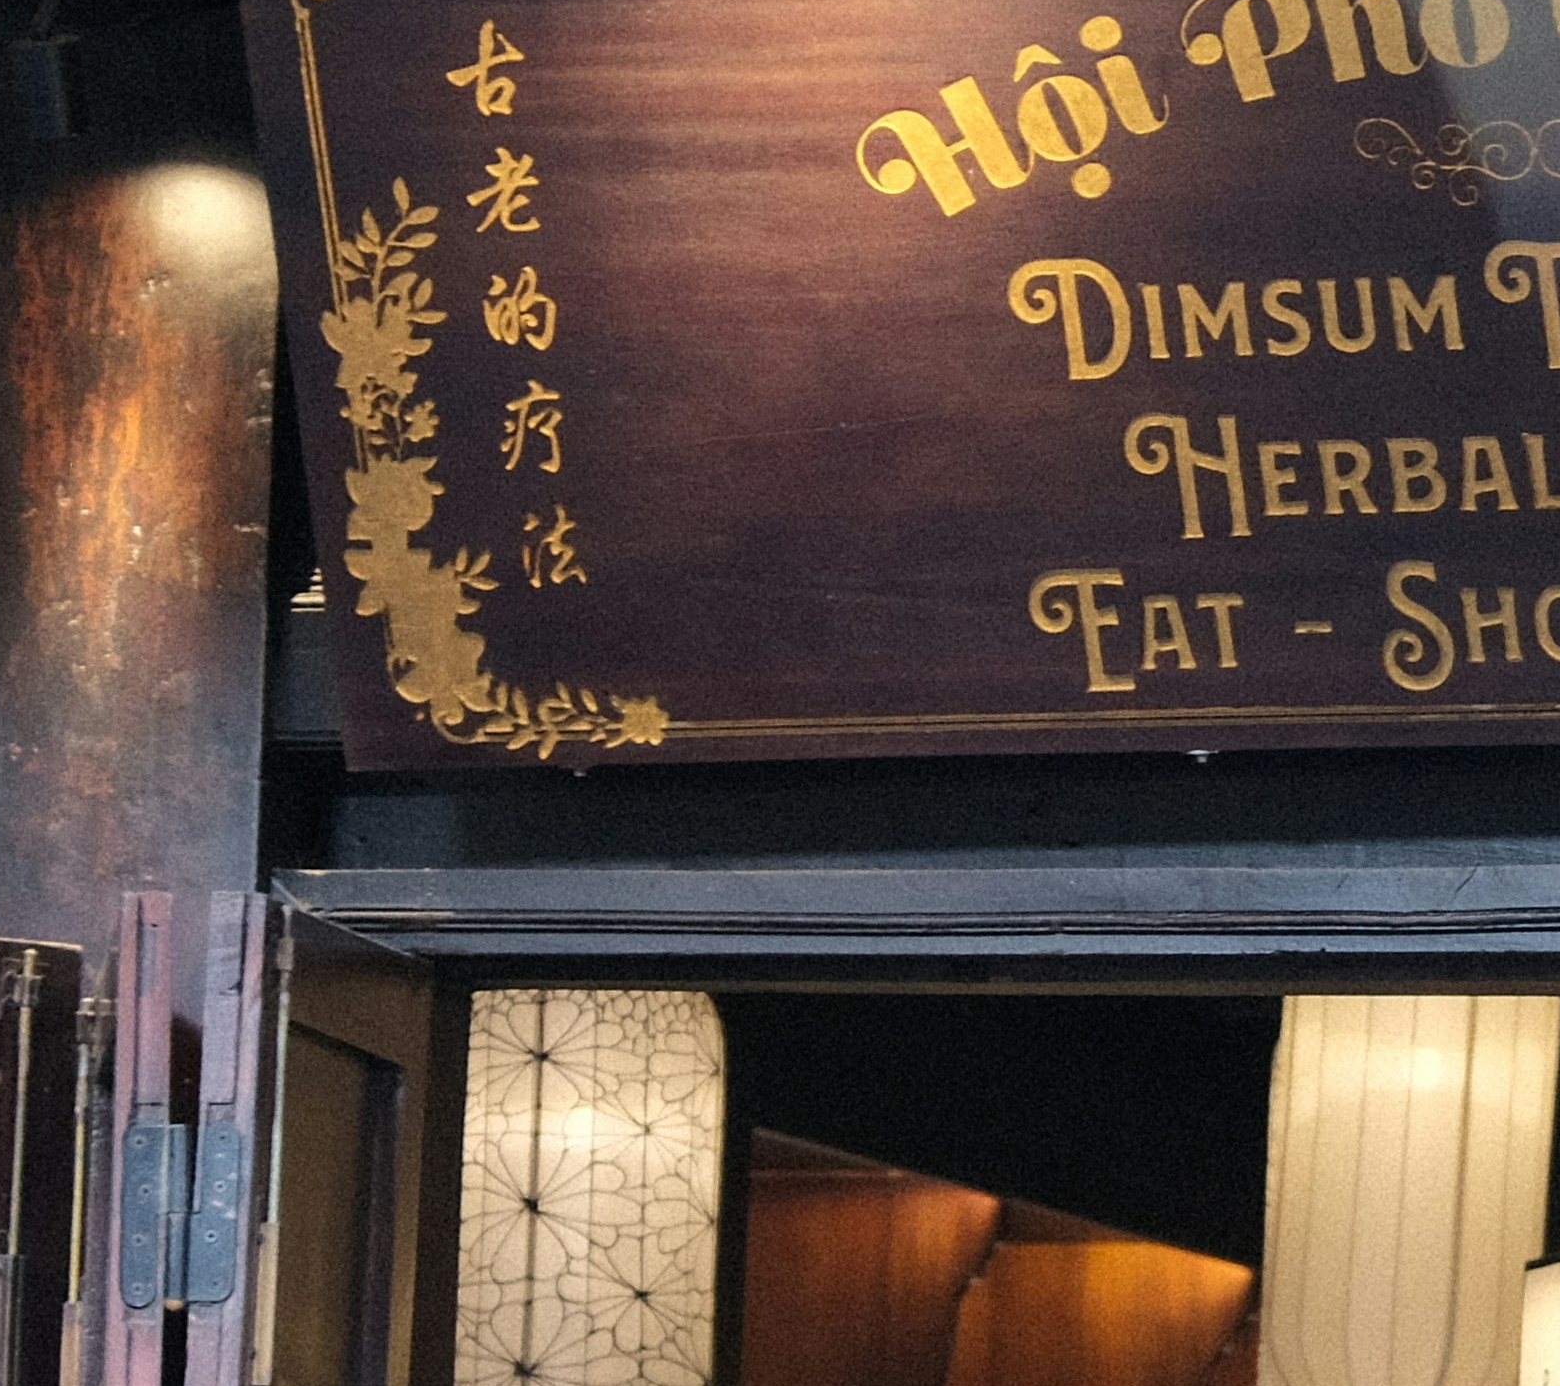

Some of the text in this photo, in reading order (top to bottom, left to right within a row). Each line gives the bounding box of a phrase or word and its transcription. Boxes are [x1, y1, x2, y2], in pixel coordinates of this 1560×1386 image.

[445, 18, 588, 591] 古老的疗法
[856, 15, 1168, 217] Hội
